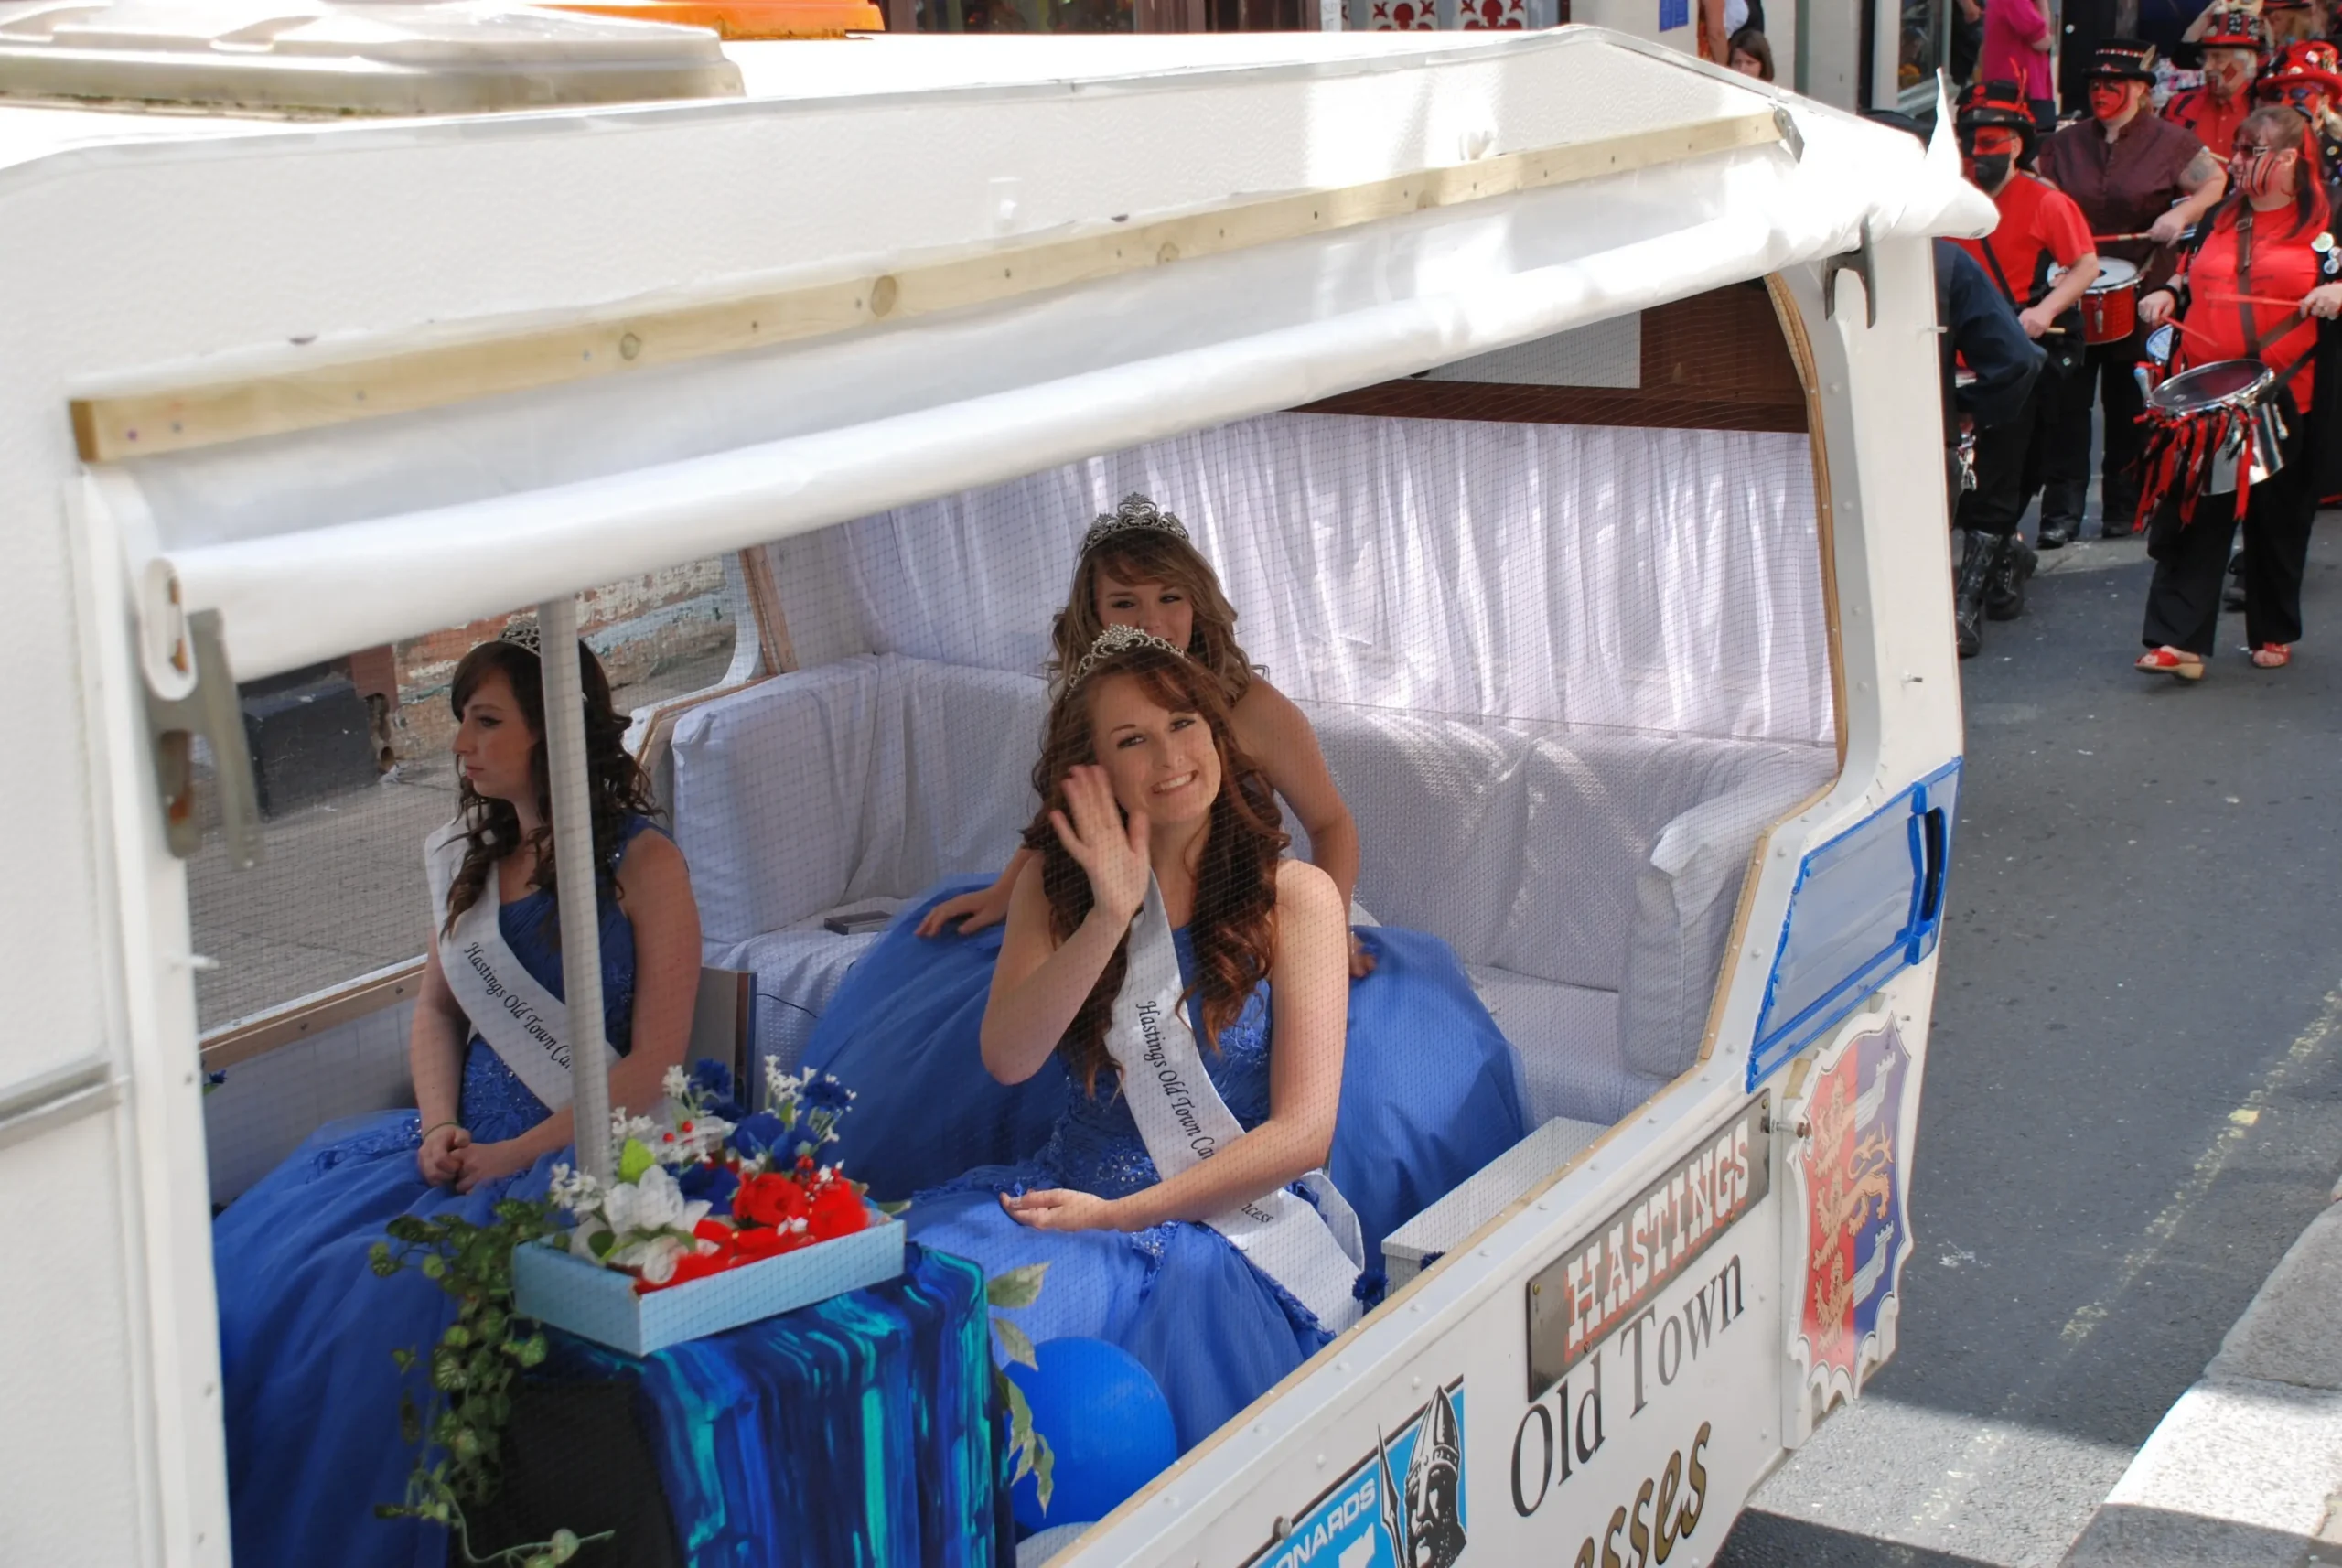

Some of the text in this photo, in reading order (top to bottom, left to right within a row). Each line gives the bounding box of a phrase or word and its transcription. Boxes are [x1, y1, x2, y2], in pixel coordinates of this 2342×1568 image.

[464, 941, 572, 1072] Hastings Old Town Ca
[1136, 1000, 1168, 1069] Hastings
[1158, 1069, 1189, 1097] Old
[1171, 1097, 1202, 1137] Town
[1563, 1117, 1749, 1364] HASTINGS
[1510, 1254, 1745, 1518] Old Town
[1271, 1477, 1377, 1568] ONARDS
